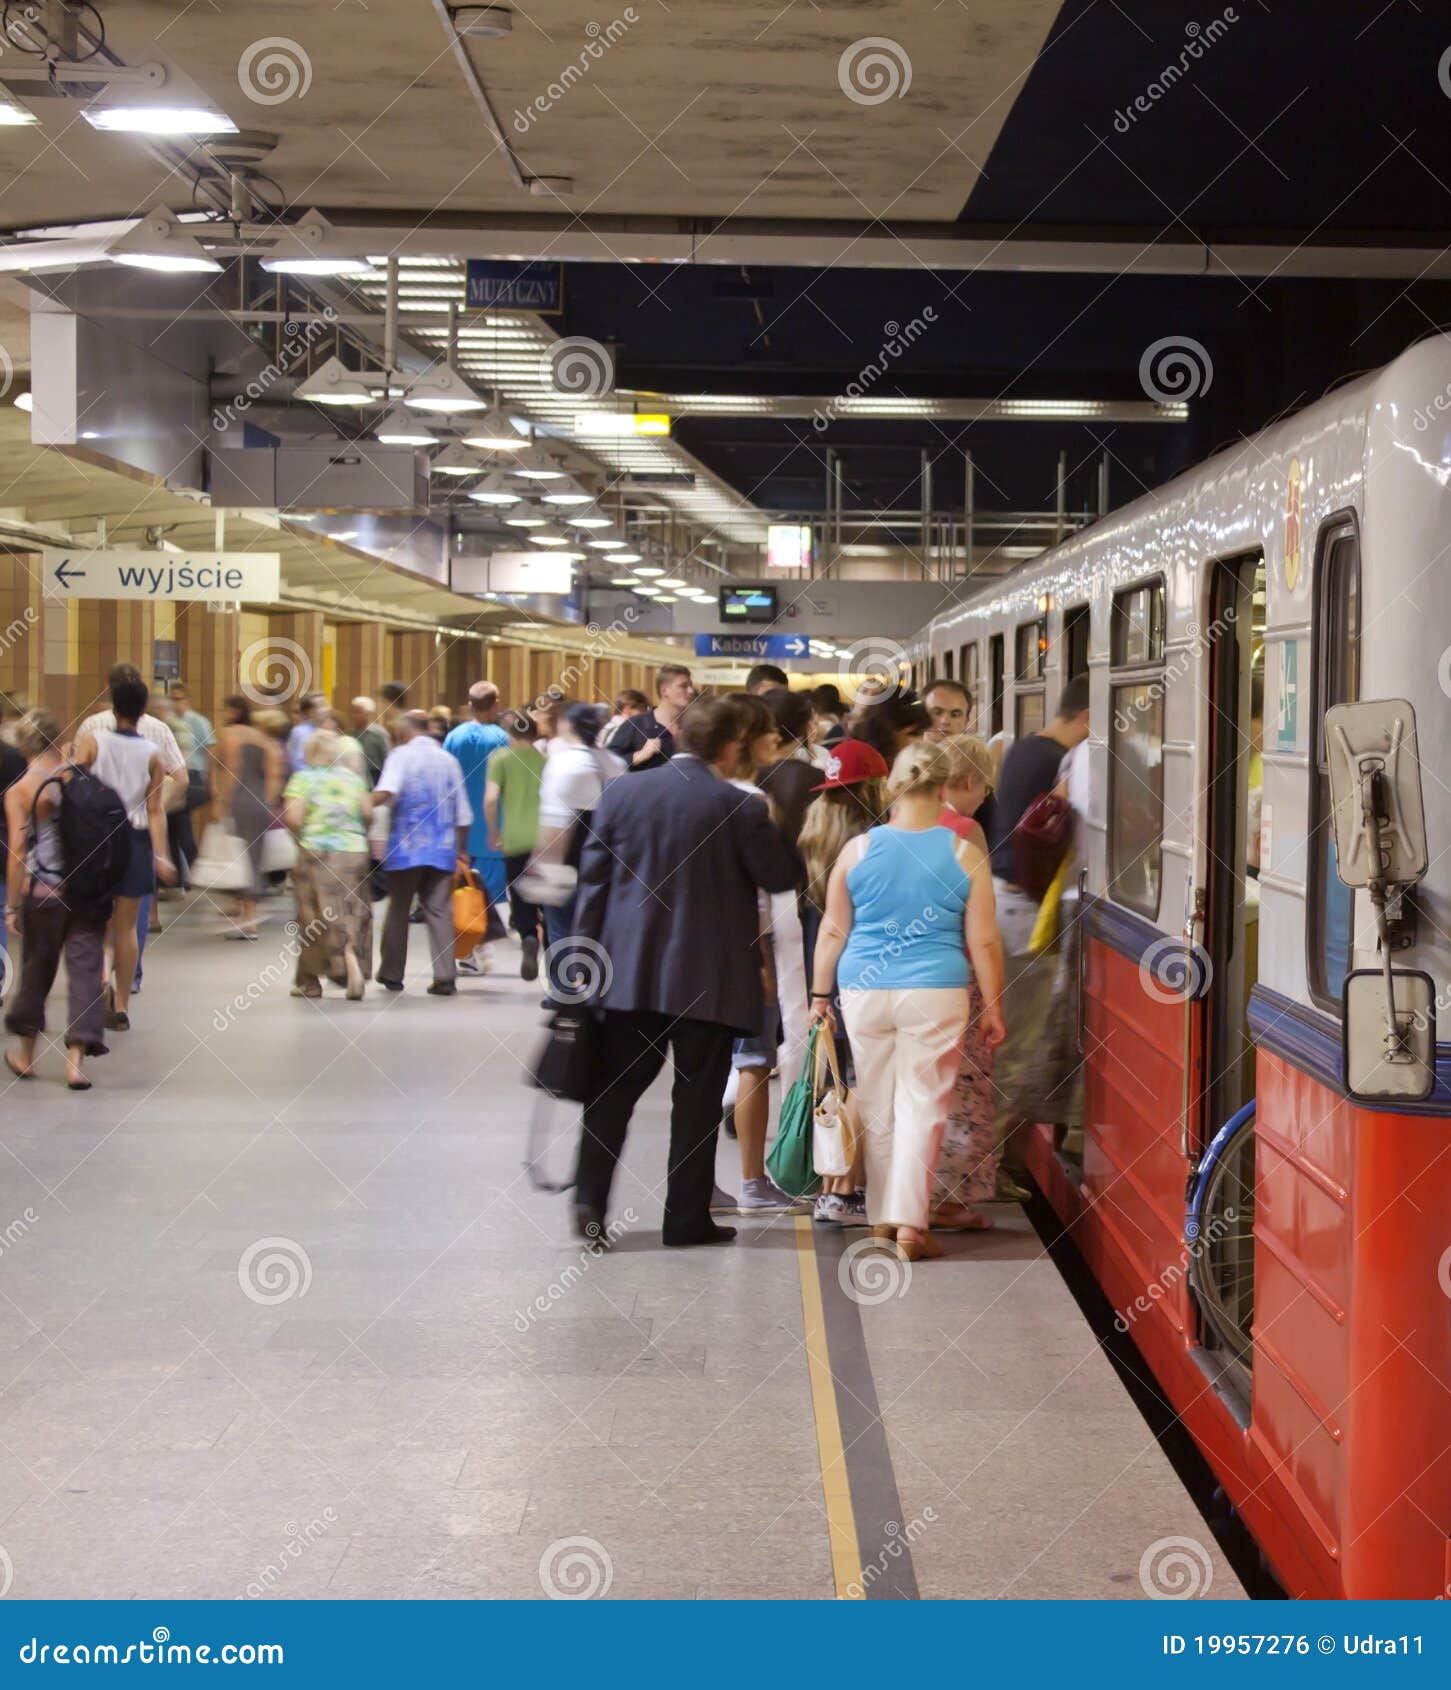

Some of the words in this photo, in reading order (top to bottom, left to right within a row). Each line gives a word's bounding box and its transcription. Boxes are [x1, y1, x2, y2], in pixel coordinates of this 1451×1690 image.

[470, 277, 557, 304] MUZYCZNY
[118, 560, 243, 594] wyjście
[711, 637, 768, 656] Kabaty
